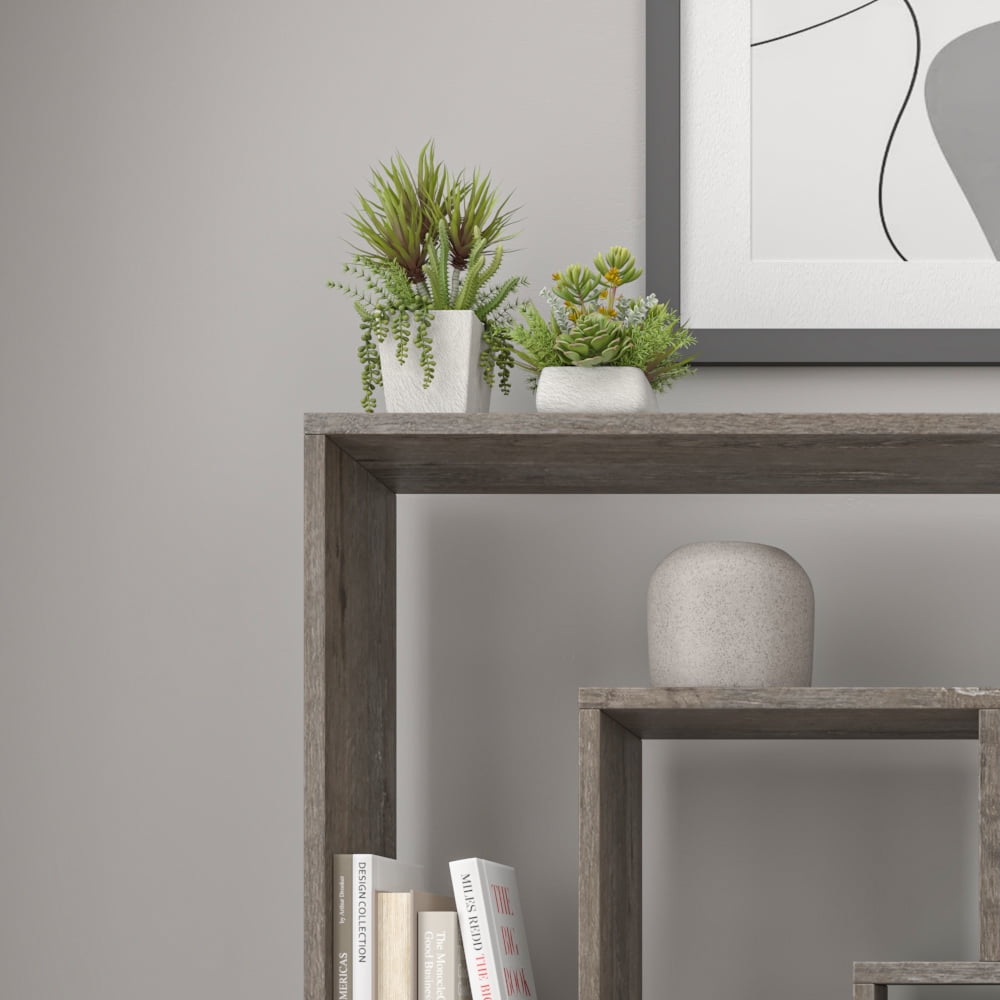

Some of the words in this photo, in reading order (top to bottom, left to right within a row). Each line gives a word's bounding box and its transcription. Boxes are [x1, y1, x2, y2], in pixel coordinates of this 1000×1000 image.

[358, 862, 367, 899] DESIGN
[460, 873, 477, 913] MILES
[358, 901, 367, 963] COLLECTION
[424, 931, 434, 958] Good
[436, 930, 446, 951] The
[468, 915, 483, 951] REDD
[475, 953, 488, 980] THE
